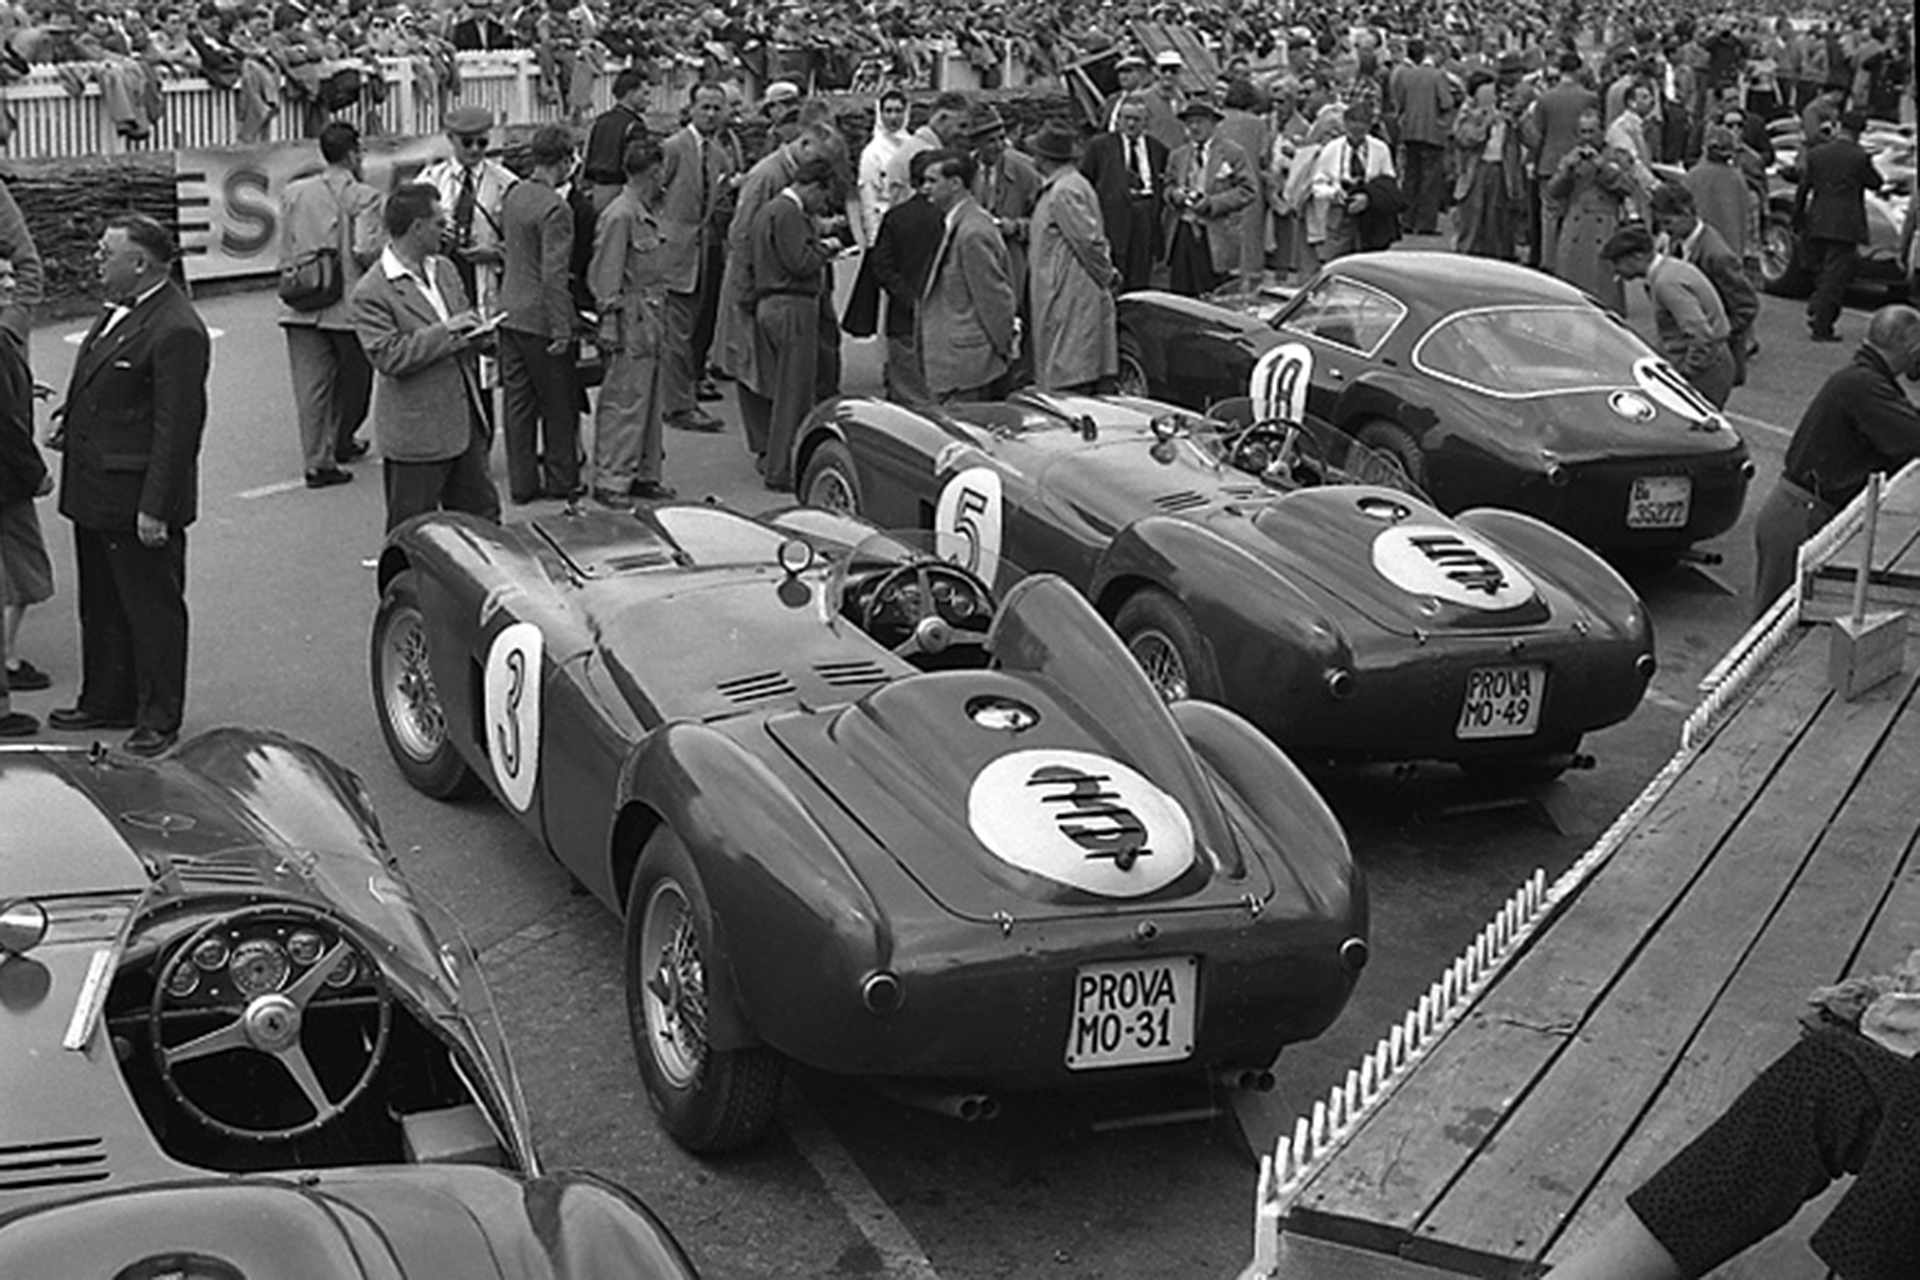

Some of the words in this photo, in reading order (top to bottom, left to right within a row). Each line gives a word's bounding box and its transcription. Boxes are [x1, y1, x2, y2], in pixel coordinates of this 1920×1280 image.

[948, 486, 988, 572] 5
[1470, 669, 1531, 699] PROVA
[498, 648, 525, 779] 3
[1078, 967, 1176, 1013] PROVA
[1076, 1007, 1171, 1055] MO-31
